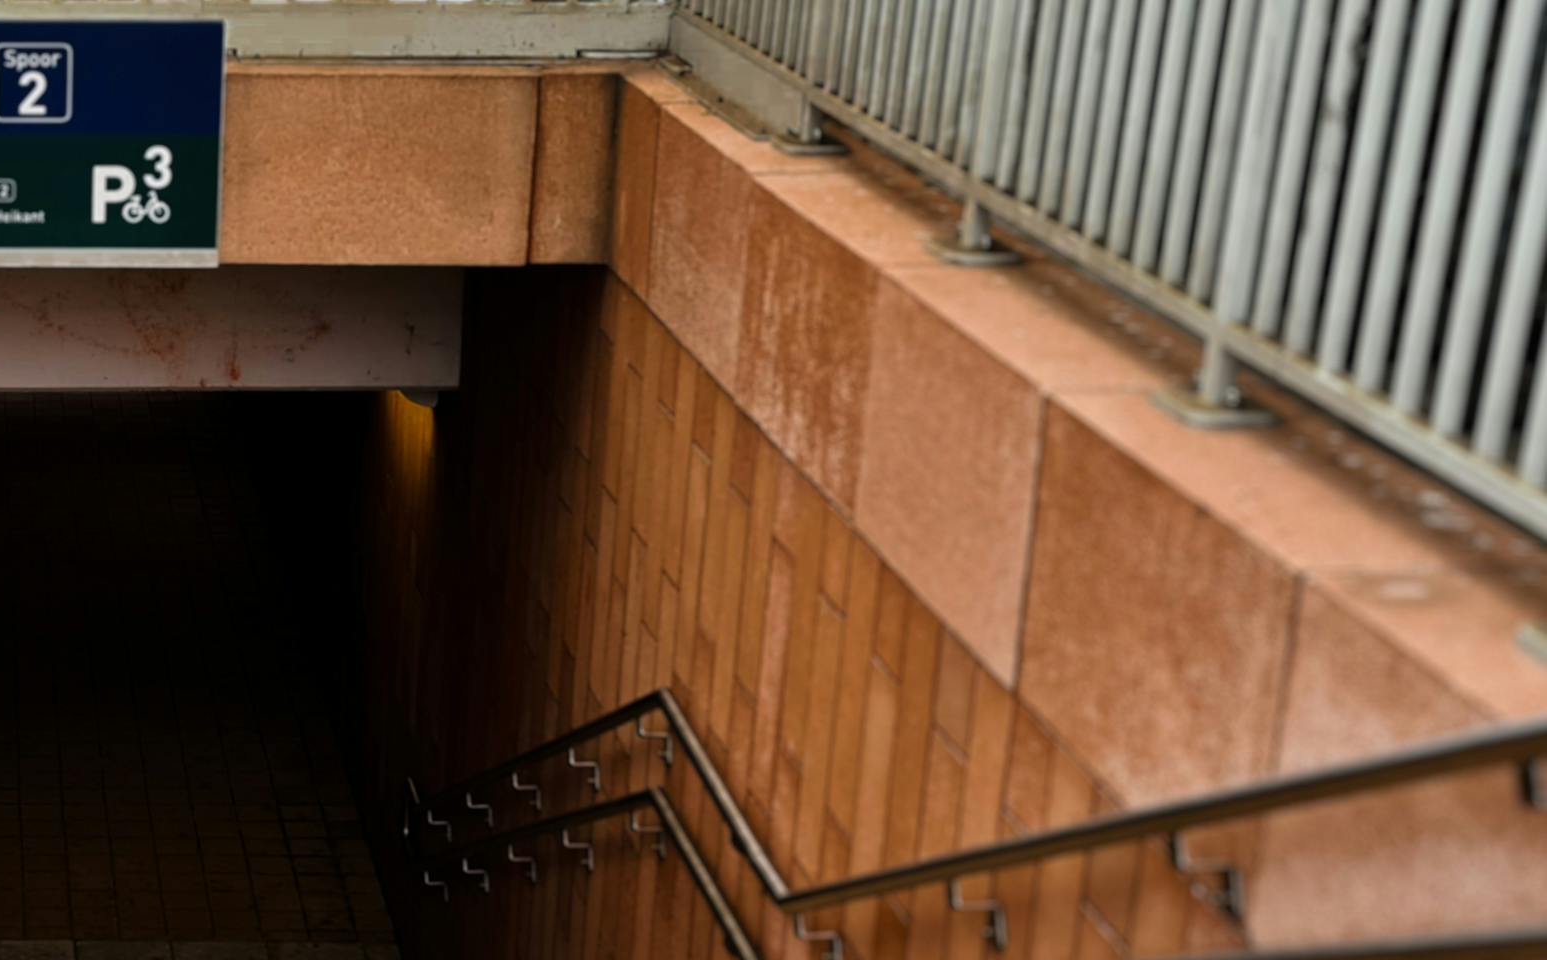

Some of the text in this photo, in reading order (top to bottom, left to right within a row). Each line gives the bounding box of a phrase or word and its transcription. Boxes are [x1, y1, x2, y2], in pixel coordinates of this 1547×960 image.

[3, 48, 62, 72] Spoor
[18, 70, 48, 116] 2
[0, 183, 10, 199] 2
[91, 164, 137, 224] P
